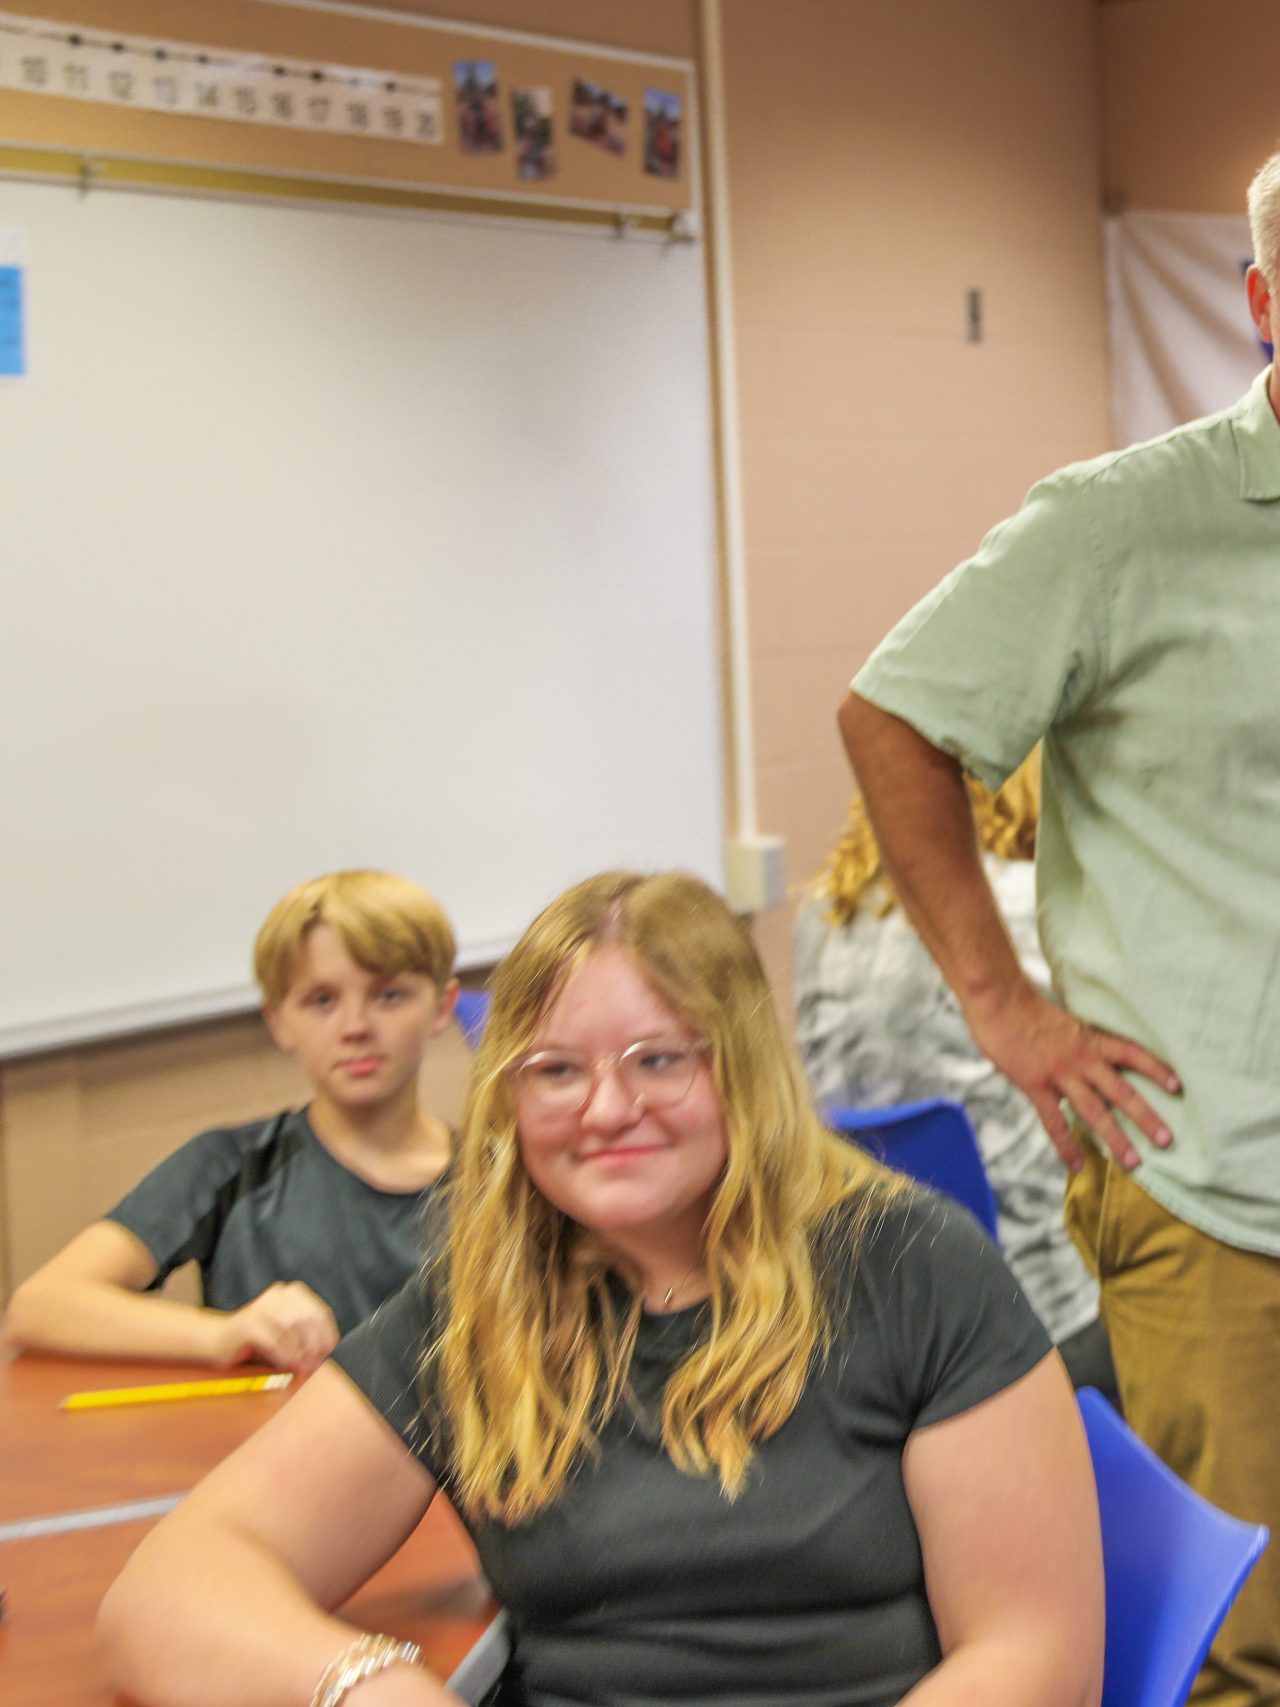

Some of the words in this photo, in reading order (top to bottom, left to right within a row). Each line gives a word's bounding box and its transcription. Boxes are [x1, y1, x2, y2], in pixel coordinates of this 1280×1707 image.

[64, 63, 88, 91] 11
[108, 69, 134, 100] 12
[309, 95, 330, 123] 17
